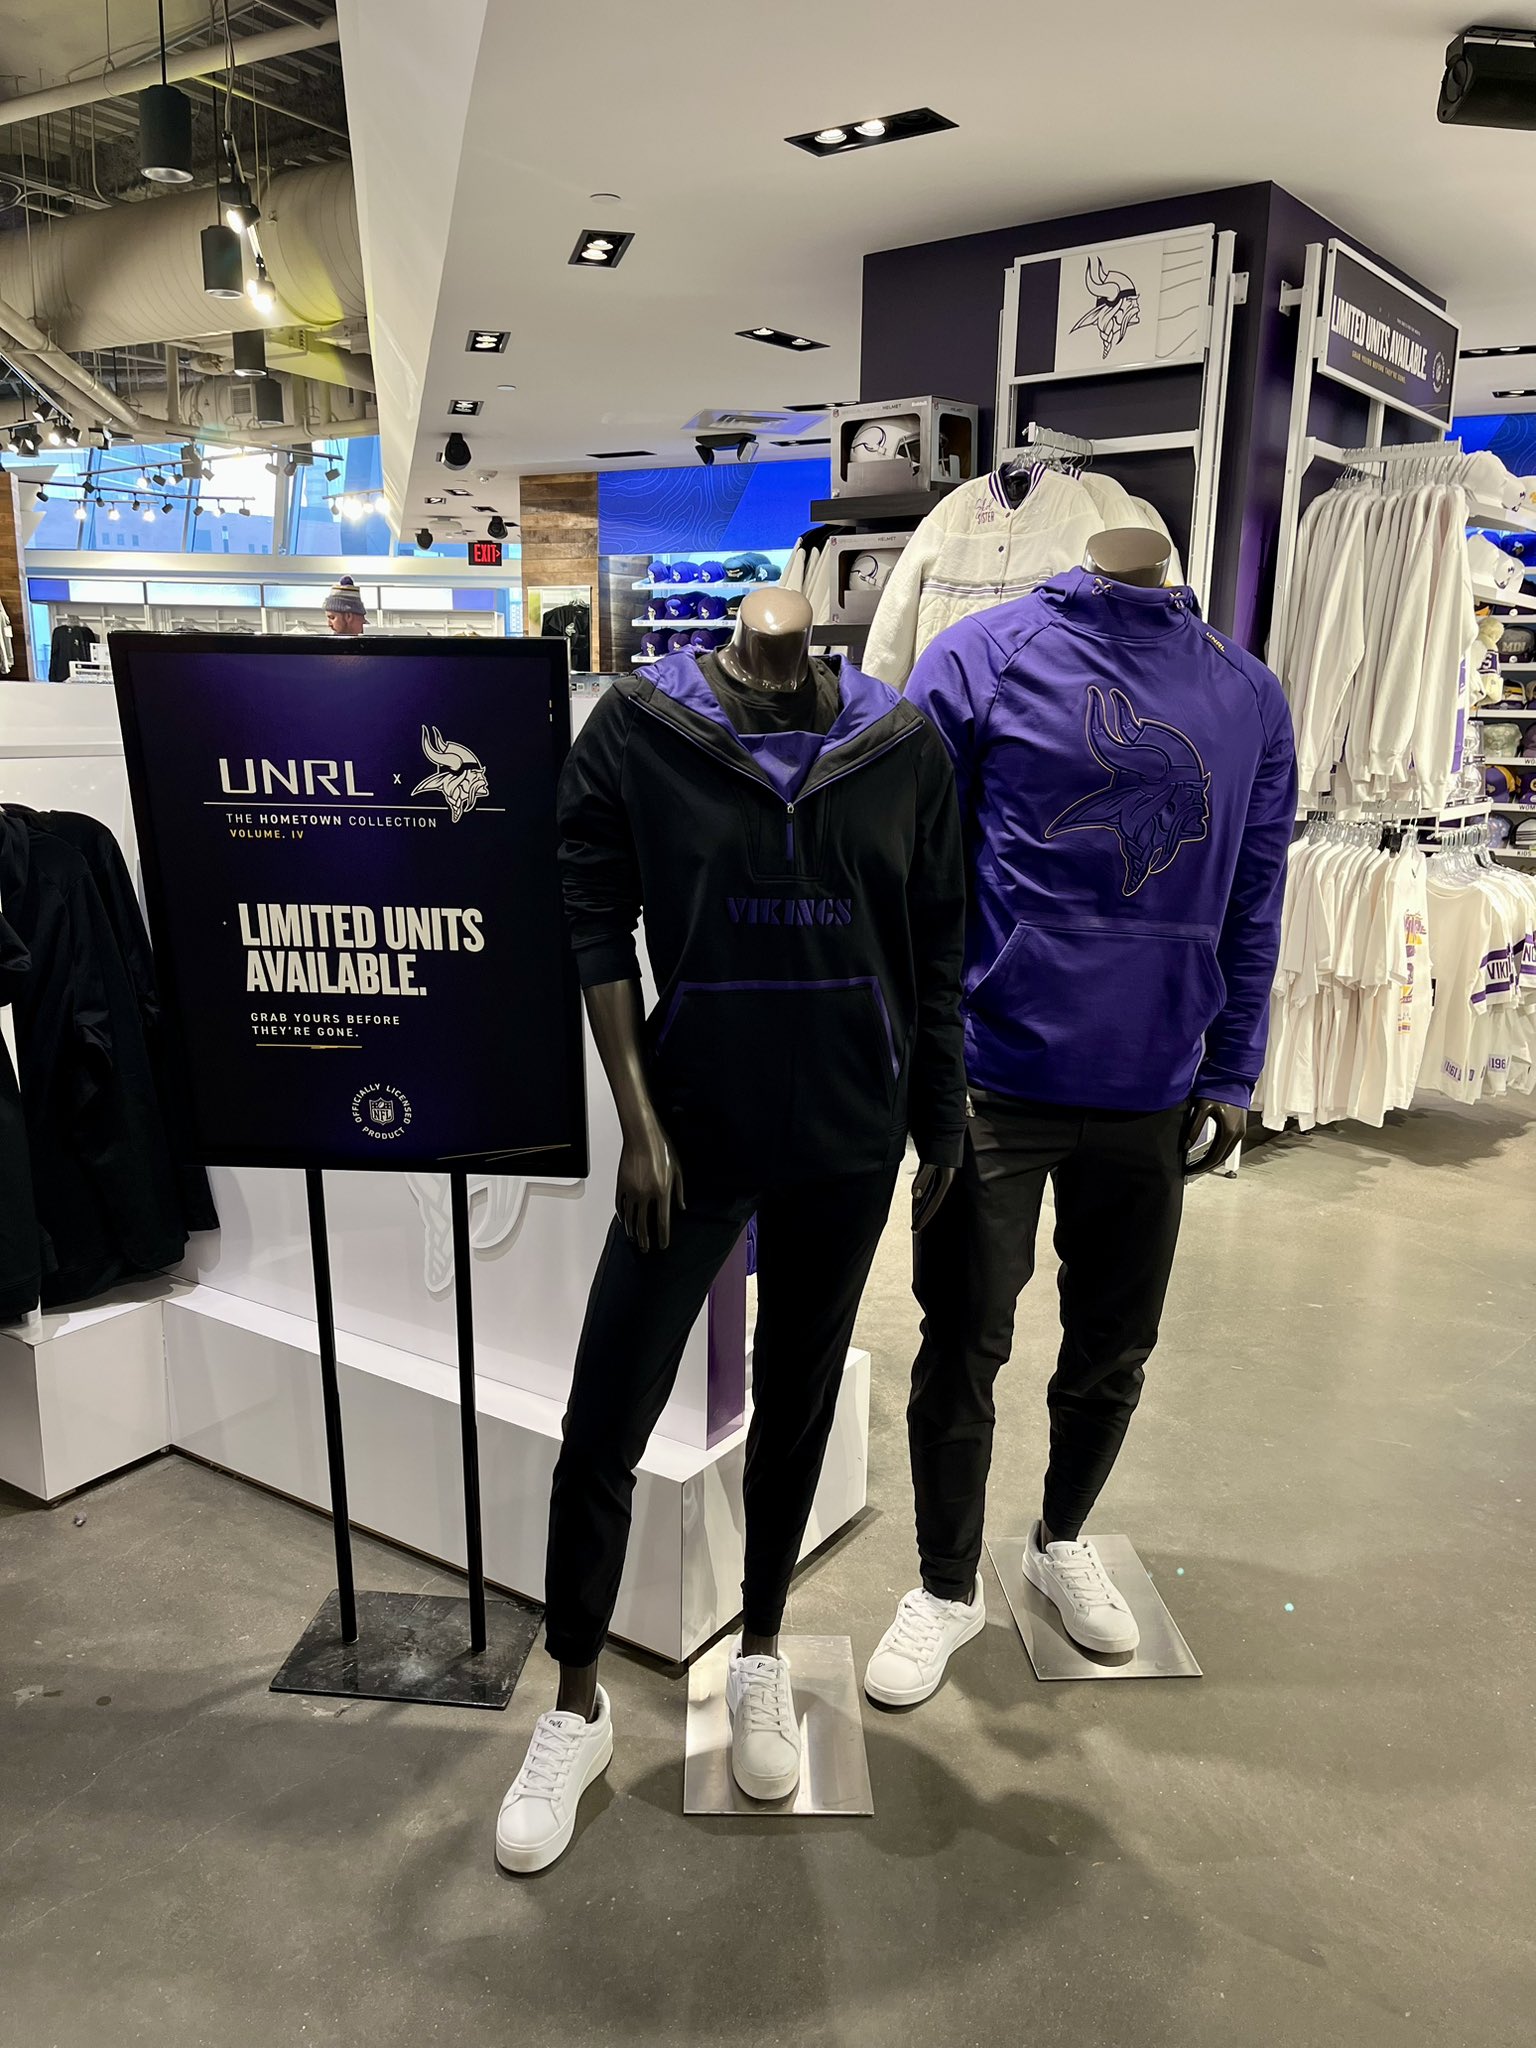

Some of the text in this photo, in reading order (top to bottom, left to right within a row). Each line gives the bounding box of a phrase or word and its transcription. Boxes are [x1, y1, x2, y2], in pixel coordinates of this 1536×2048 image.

[1331, 295, 1366, 346] LIMITED
[1365, 315, 1391, 360] UNITS
[474, 544, 496, 562] EXIT
[1205, 631, 1226, 653] UNRL
[219, 758, 374, 796] UNRL
[226, 813, 437, 828] THE HOMETOWN COLLECTION
[230, 829, 304, 839] VOLUME. IV
[726, 896, 852, 926] VIKINGS
[238, 903, 485, 953] LIMITED UNITS
[246, 950, 428, 996] AVAILABLE.
[250, 1013, 400, 1025] GRAB YOURS BEFORE
[252, 1026, 359, 1037] THEY'RE GONE.
[352, 1083, 412, 1124] OFFICIALLY LICENSED
[372, 1109, 392, 1121] NFL
[361, 1126, 405, 1139] PRODUCT
